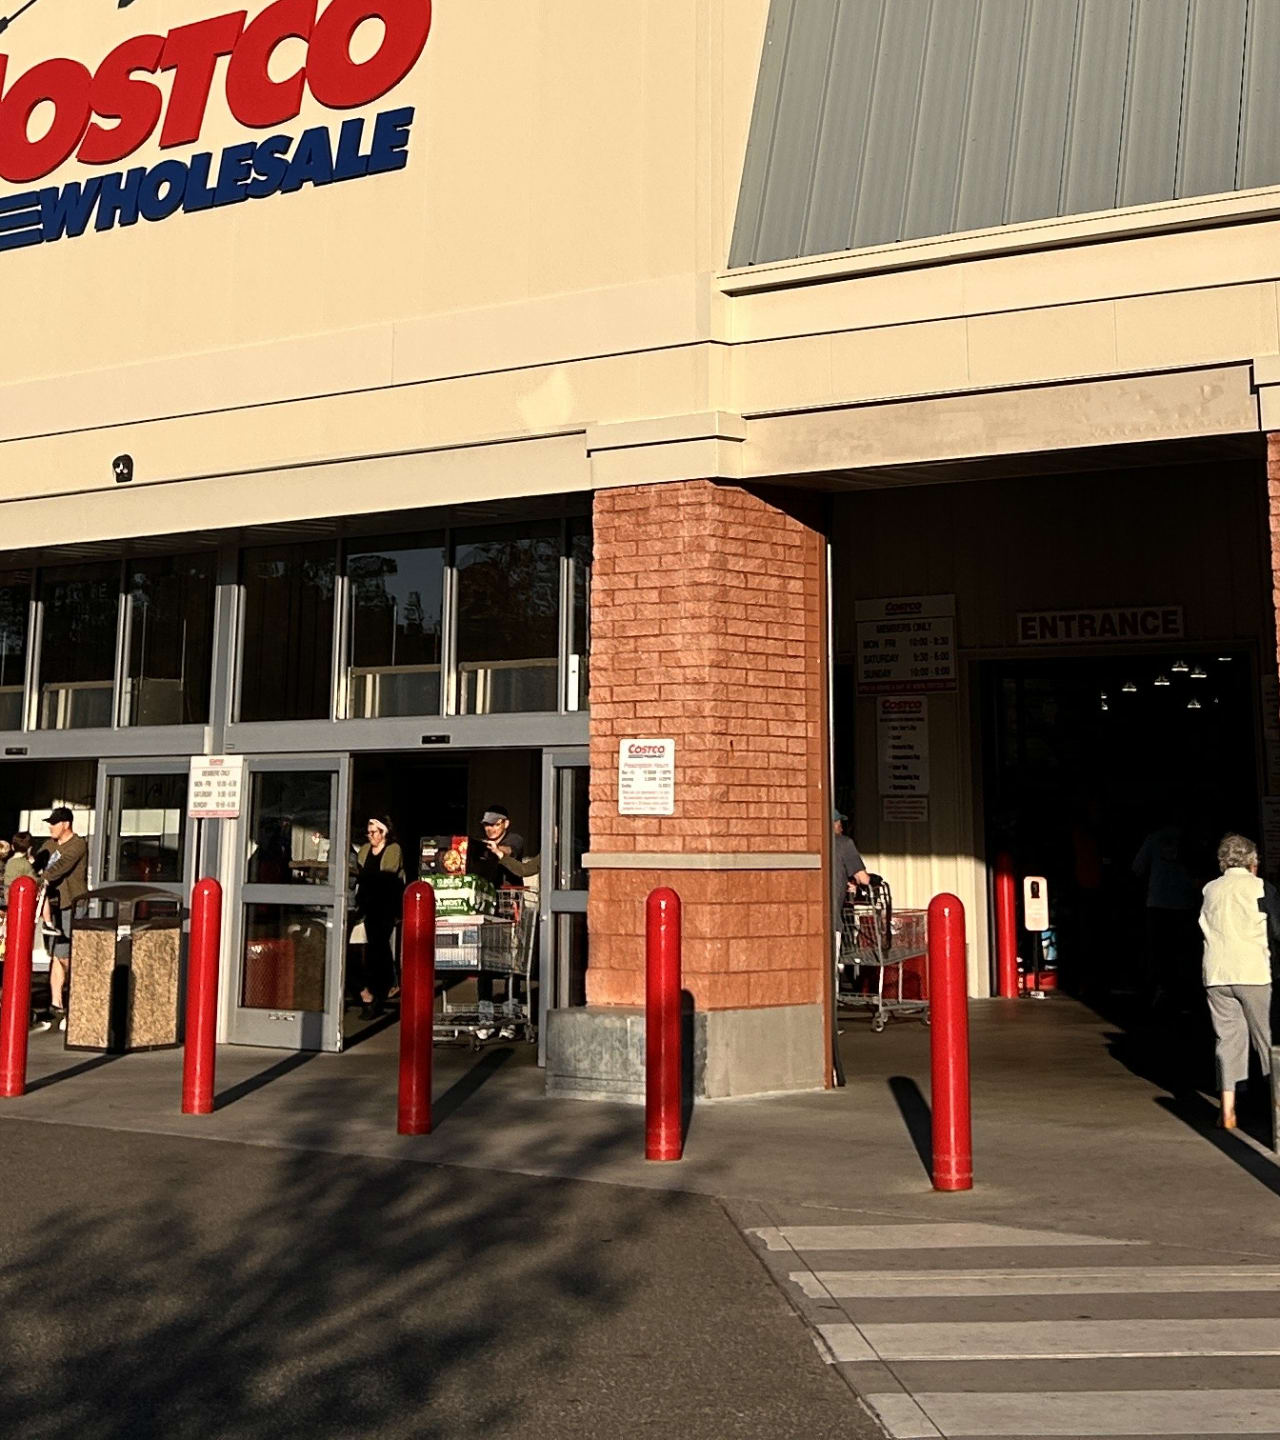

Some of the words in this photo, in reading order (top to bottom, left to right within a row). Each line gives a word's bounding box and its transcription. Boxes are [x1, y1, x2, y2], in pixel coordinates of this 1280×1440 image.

[39, 106, 415, 242] WHOLESALE
[876, 623, 911, 633] MEMBERS
[913, 622, 932, 632] ONLY
[1021, 610, 1180, 640] ENTRANCE
[863, 639, 879, 649] MON
[863, 654, 899, 664] SATURDAY
[863, 669, 891, 679] SUNDAY
[882, 700, 922, 710] COSTCO
[628, 744, 665, 754] COSTCO
